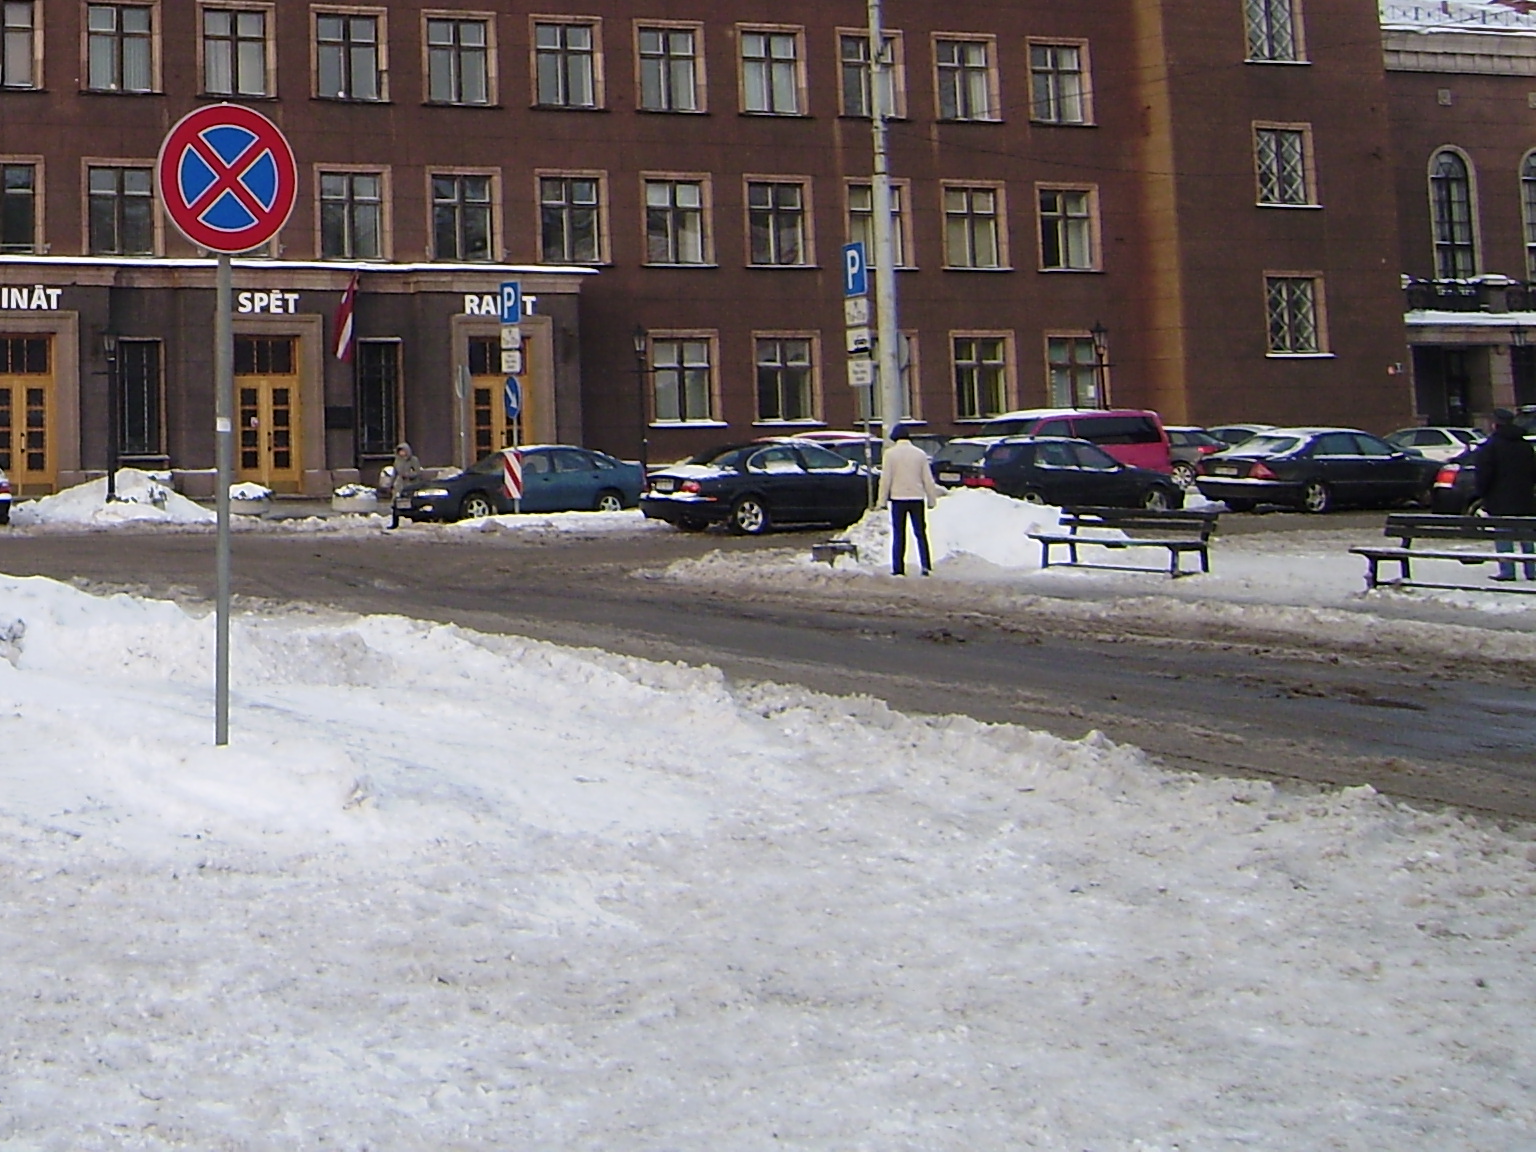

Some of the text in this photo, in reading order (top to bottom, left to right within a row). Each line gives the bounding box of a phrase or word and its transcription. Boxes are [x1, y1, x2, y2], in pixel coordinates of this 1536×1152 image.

[845, 249, 860, 290] P
[237, 290, 299, 314] SPĒT
[464, 294, 537, 316] RAT
[503, 286, 516, 319] P
